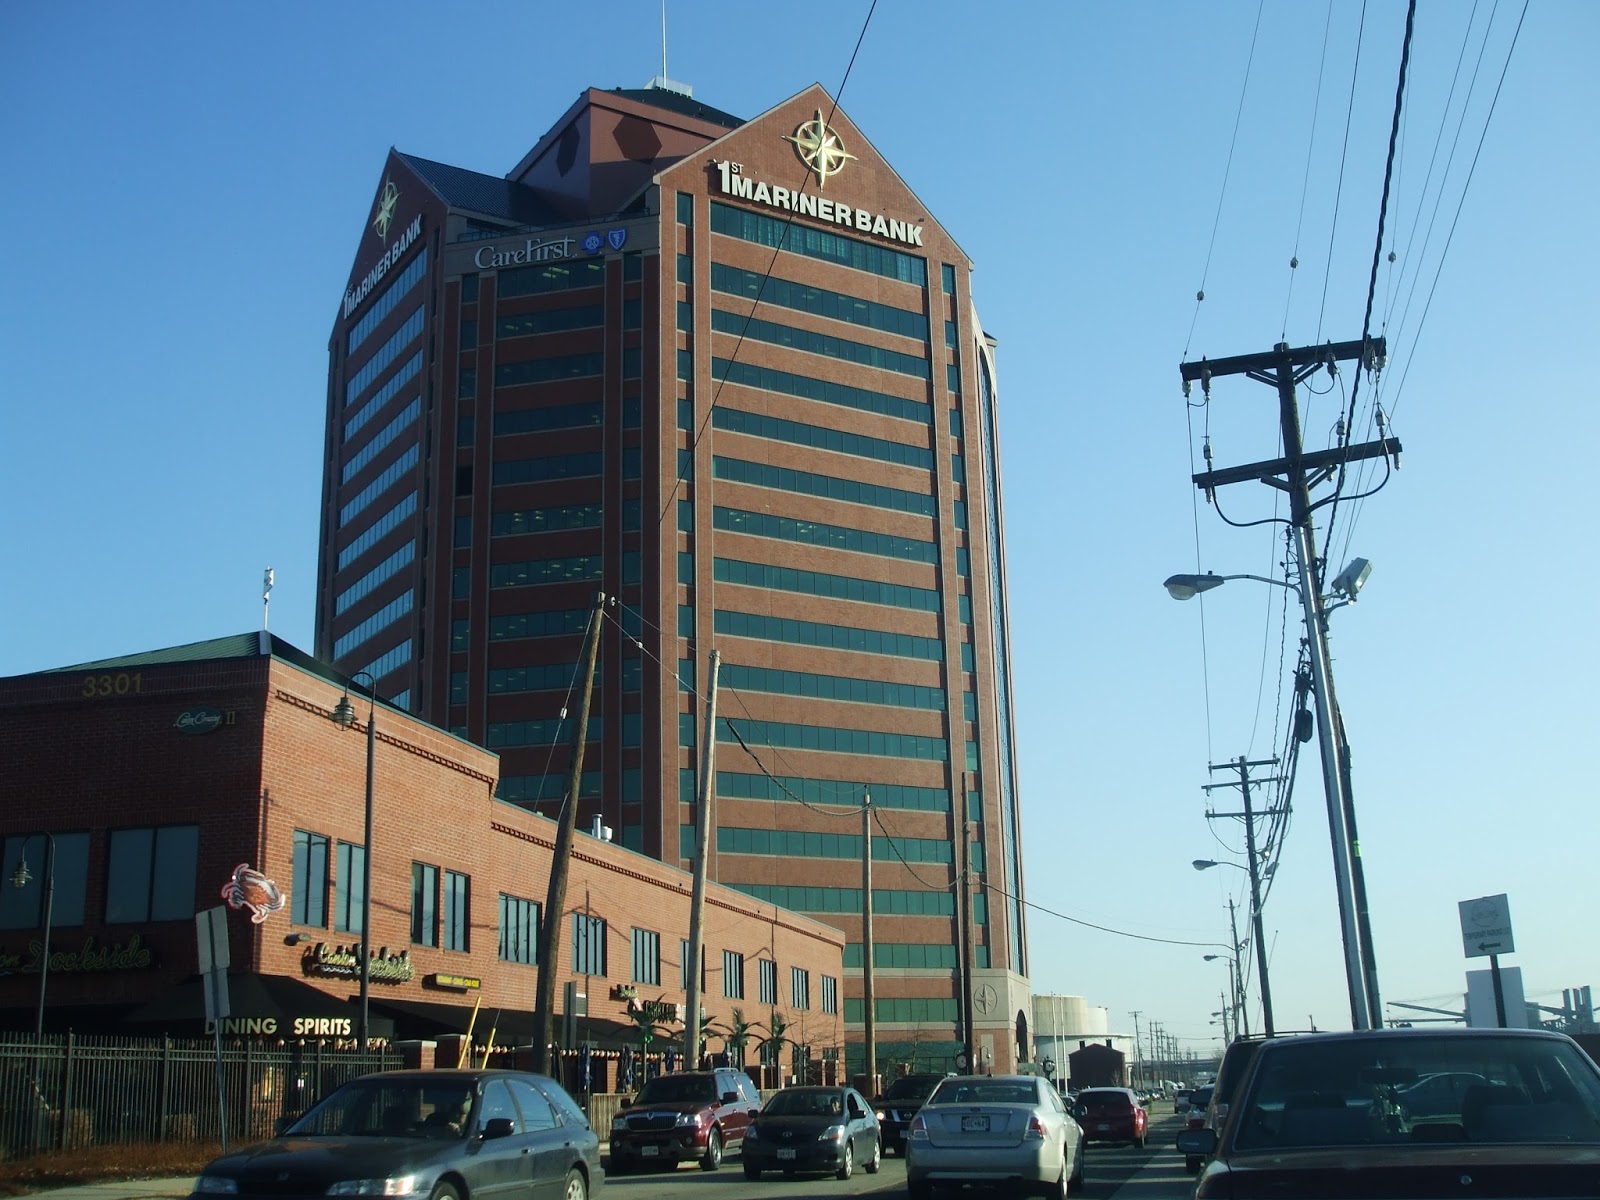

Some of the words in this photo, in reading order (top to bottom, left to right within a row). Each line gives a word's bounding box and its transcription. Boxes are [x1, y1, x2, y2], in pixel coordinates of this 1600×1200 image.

[731, 173, 853, 227] MARINER
[855, 208, 923, 247] BANK
[347, 250, 391, 315] MARINER
[391, 213, 422, 265] BANK
[474, 235, 576, 269] CareFirst
[82, 672, 142, 698] 3301
[294, 1018, 351, 1035] SPIRITS
